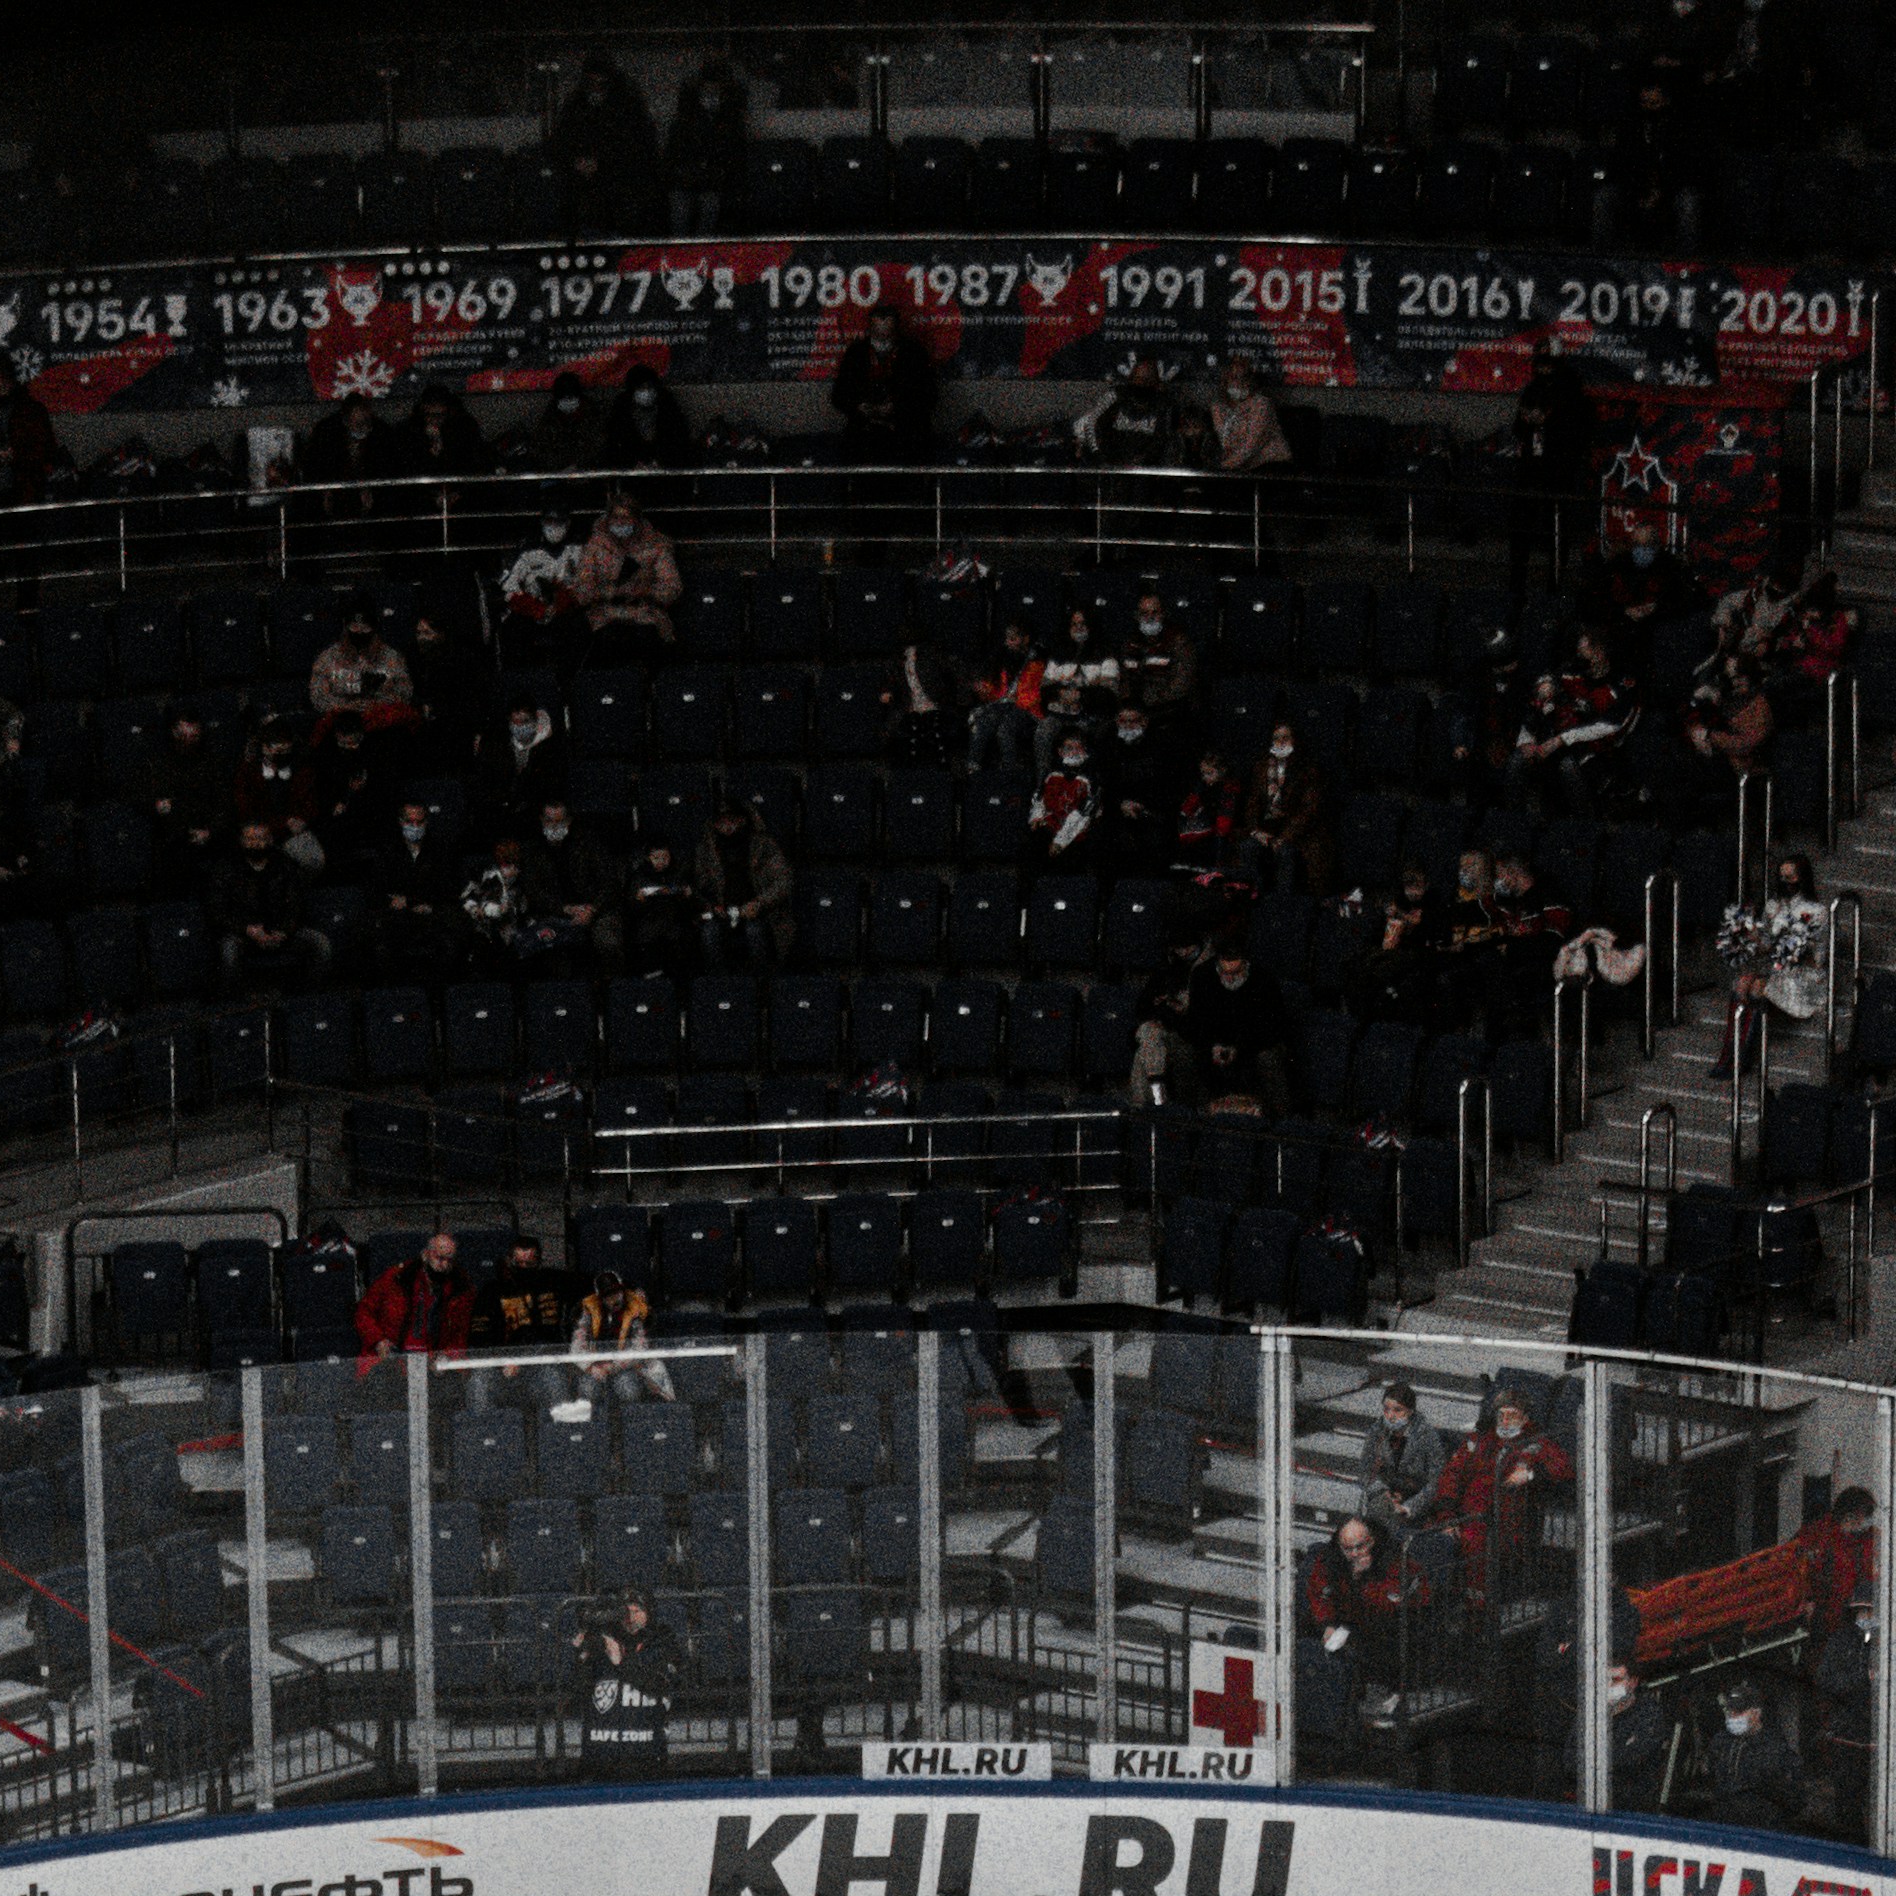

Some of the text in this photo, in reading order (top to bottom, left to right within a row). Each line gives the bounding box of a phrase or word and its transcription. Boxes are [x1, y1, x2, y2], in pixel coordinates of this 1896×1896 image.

[403, 277, 517, 324] 1969
[540, 270, 652, 318] 1977
[760, 264, 882, 308] 1980
[905, 263, 1019, 307] 1987
[1099, 265, 1206, 310] 1991
[1228, 268, 1346, 312] 2015
[1398, 272, 1510, 318] 2016
[1558, 280, 1670, 327] 2019
[42, 297, 156, 343] 1954
[213, 287, 331, 334] 1963
[1718, 289, 1838, 335] 2020
[885, 1745, 1031, 1777] KHL.RU
[1113, 1748, 1255, 1782] KHL.RU
